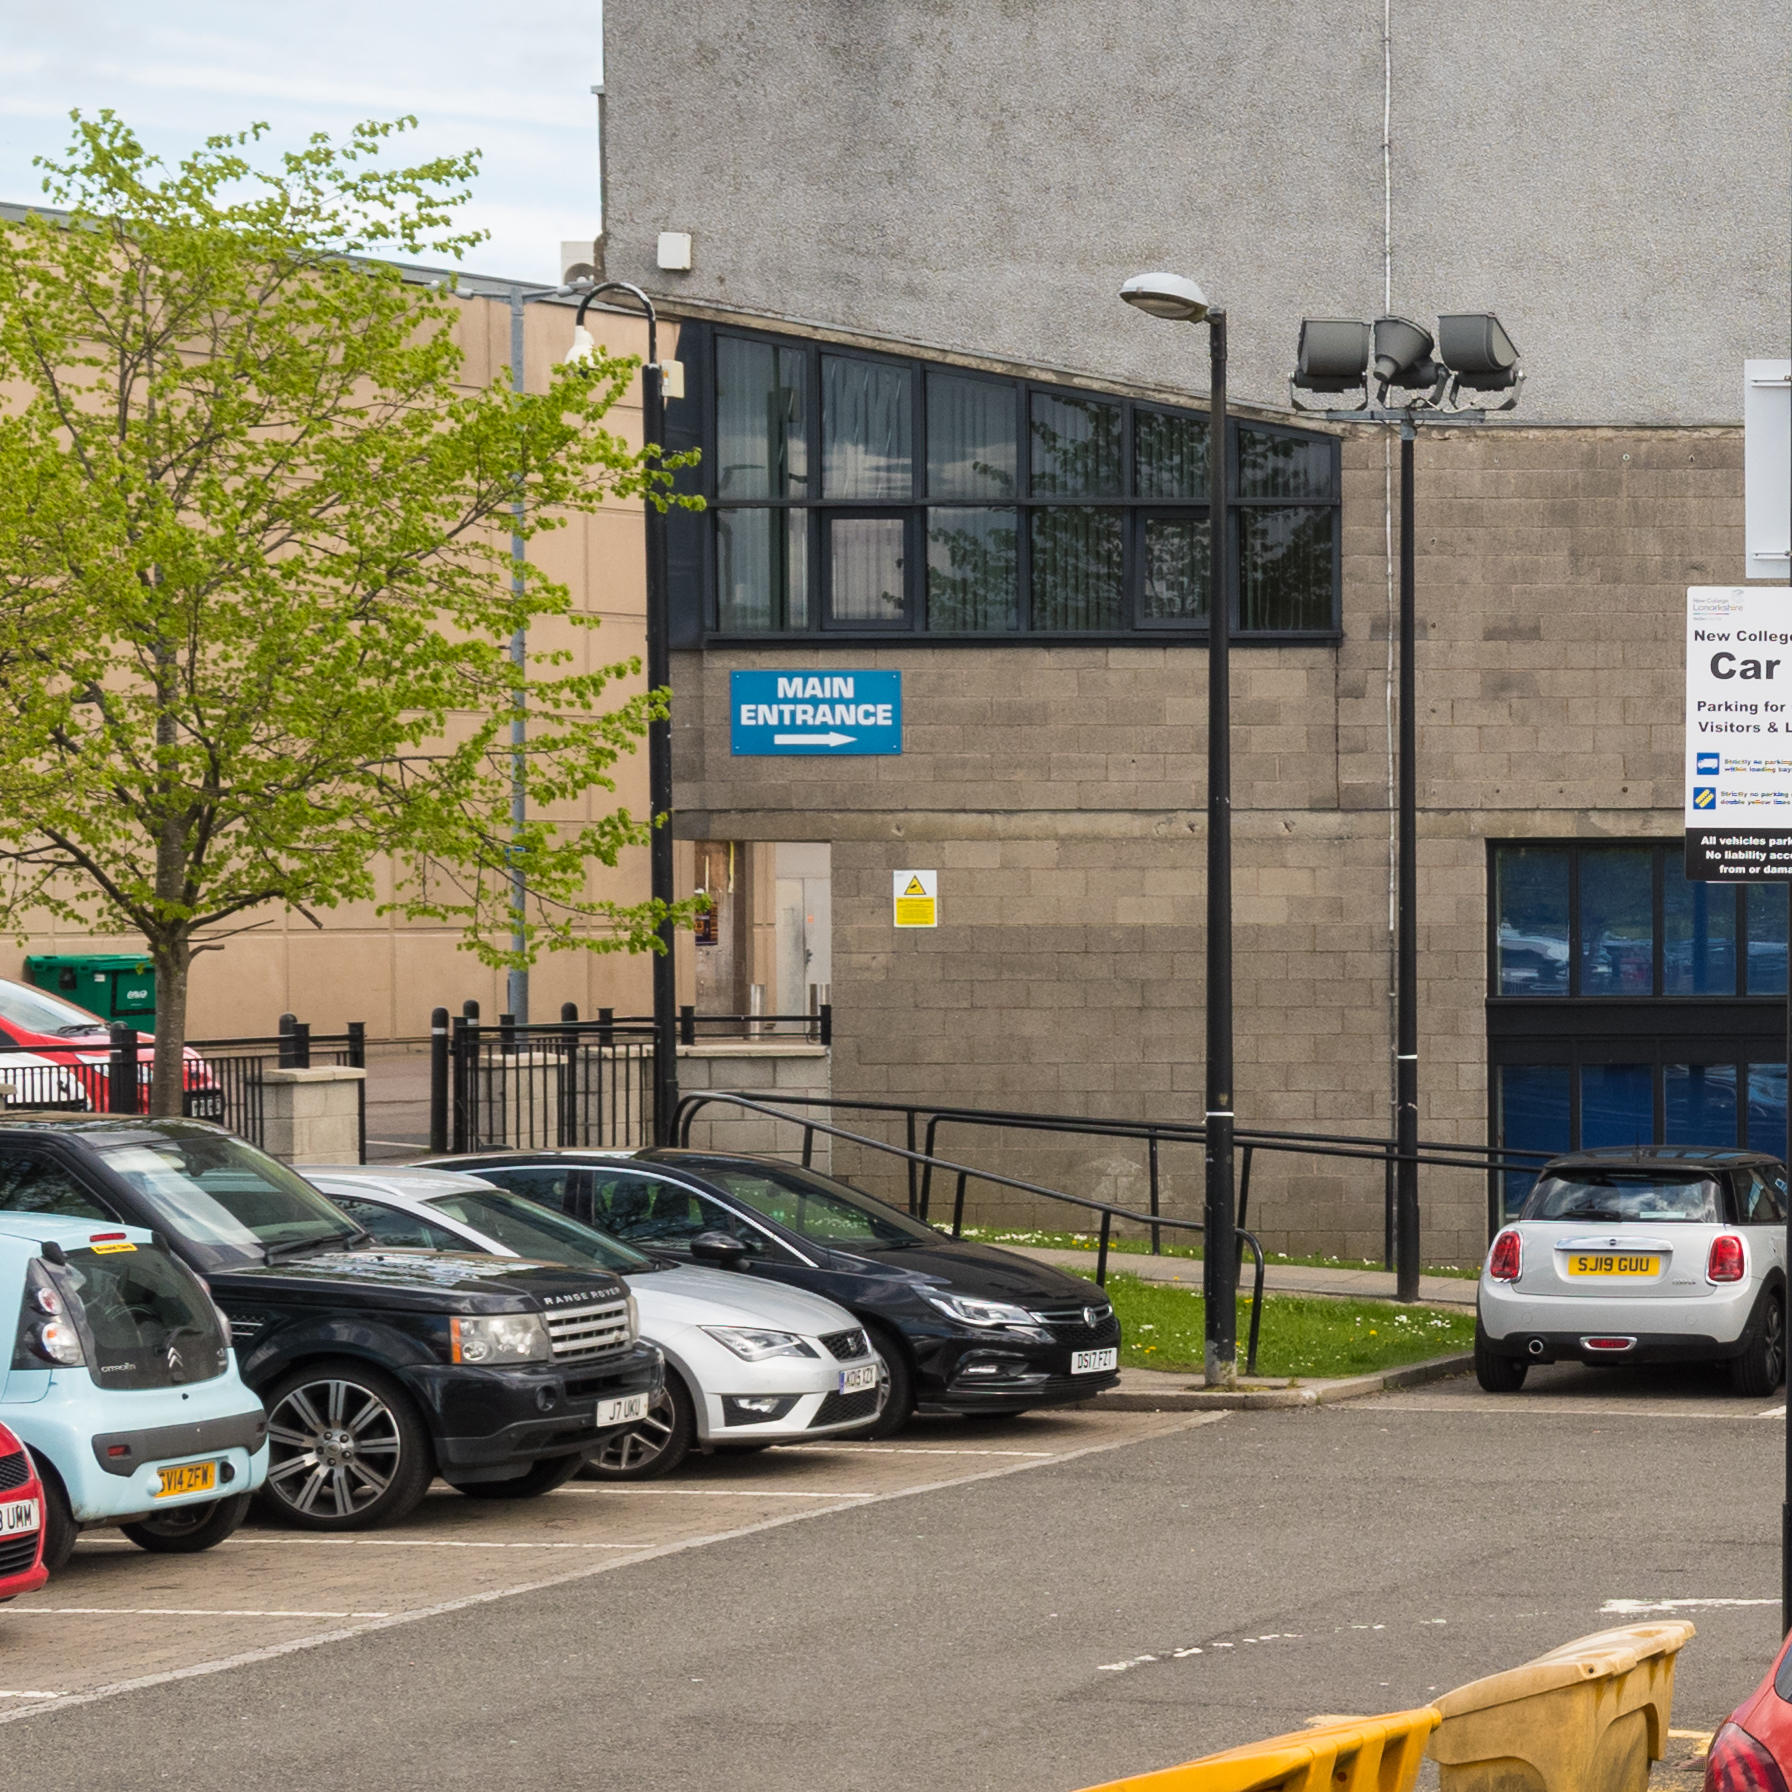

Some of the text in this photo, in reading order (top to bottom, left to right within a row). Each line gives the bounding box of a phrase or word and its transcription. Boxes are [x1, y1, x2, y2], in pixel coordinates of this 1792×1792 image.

[1694, 630, 1730, 642] New
[1710, 652, 1781, 680] Car
[777, 677, 854, 699] MAIN
[1697, 701, 1758, 714] Parking
[1764, 701, 1786, 712] for
[740, 703, 892, 726] ENTRANCE
[1698, 722, 1761, 733] Visitors
[1768, 722, 1778, 733] &
[1701, 836, 1716, 846] All
[1719, 836, 1766, 846] vehicles
[1706, 850, 1721, 860] No
[1724, 851, 1767, 862] liability
[1719, 865, 1746, 874] from
[1578, 1257, 1650, 1272] SJ19 GUU
[544, 1292, 589, 1305] RANGE
[1078, 1352, 1097, 1369] DS17
[609, 1401, 622, 1420] J7
